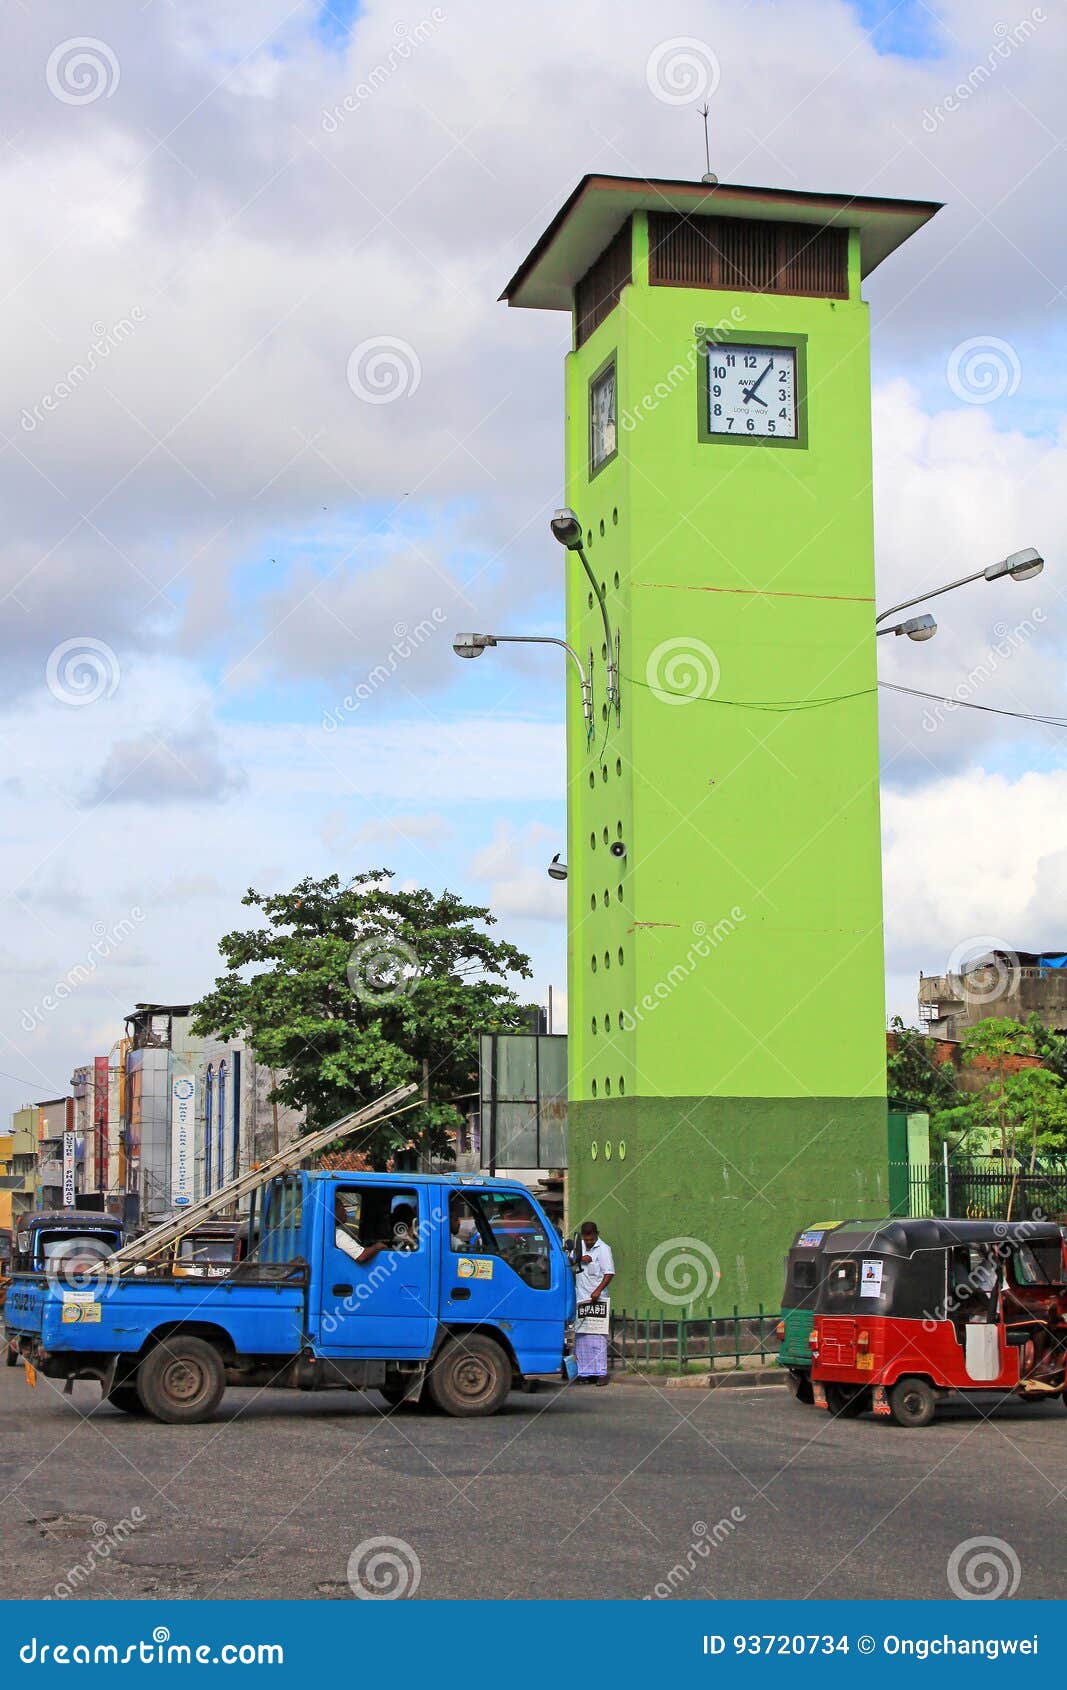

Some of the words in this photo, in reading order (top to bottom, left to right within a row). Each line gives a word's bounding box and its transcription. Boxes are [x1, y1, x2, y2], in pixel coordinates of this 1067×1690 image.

[726, 354, 736, 367] 11
[743, 355, 757, 369] 12
[713, 366, 727, 379] 10
[778, 370, 787, 382] 2
[713, 385, 722, 397] 9
[778, 389, 786, 401] 3
[713, 403, 722, 416] 8
[778, 407, 787, 419] 4
[726, 417, 735, 430] 7
[746, 418, 755, 431] 6
[767, 420, 776, 432] 5
